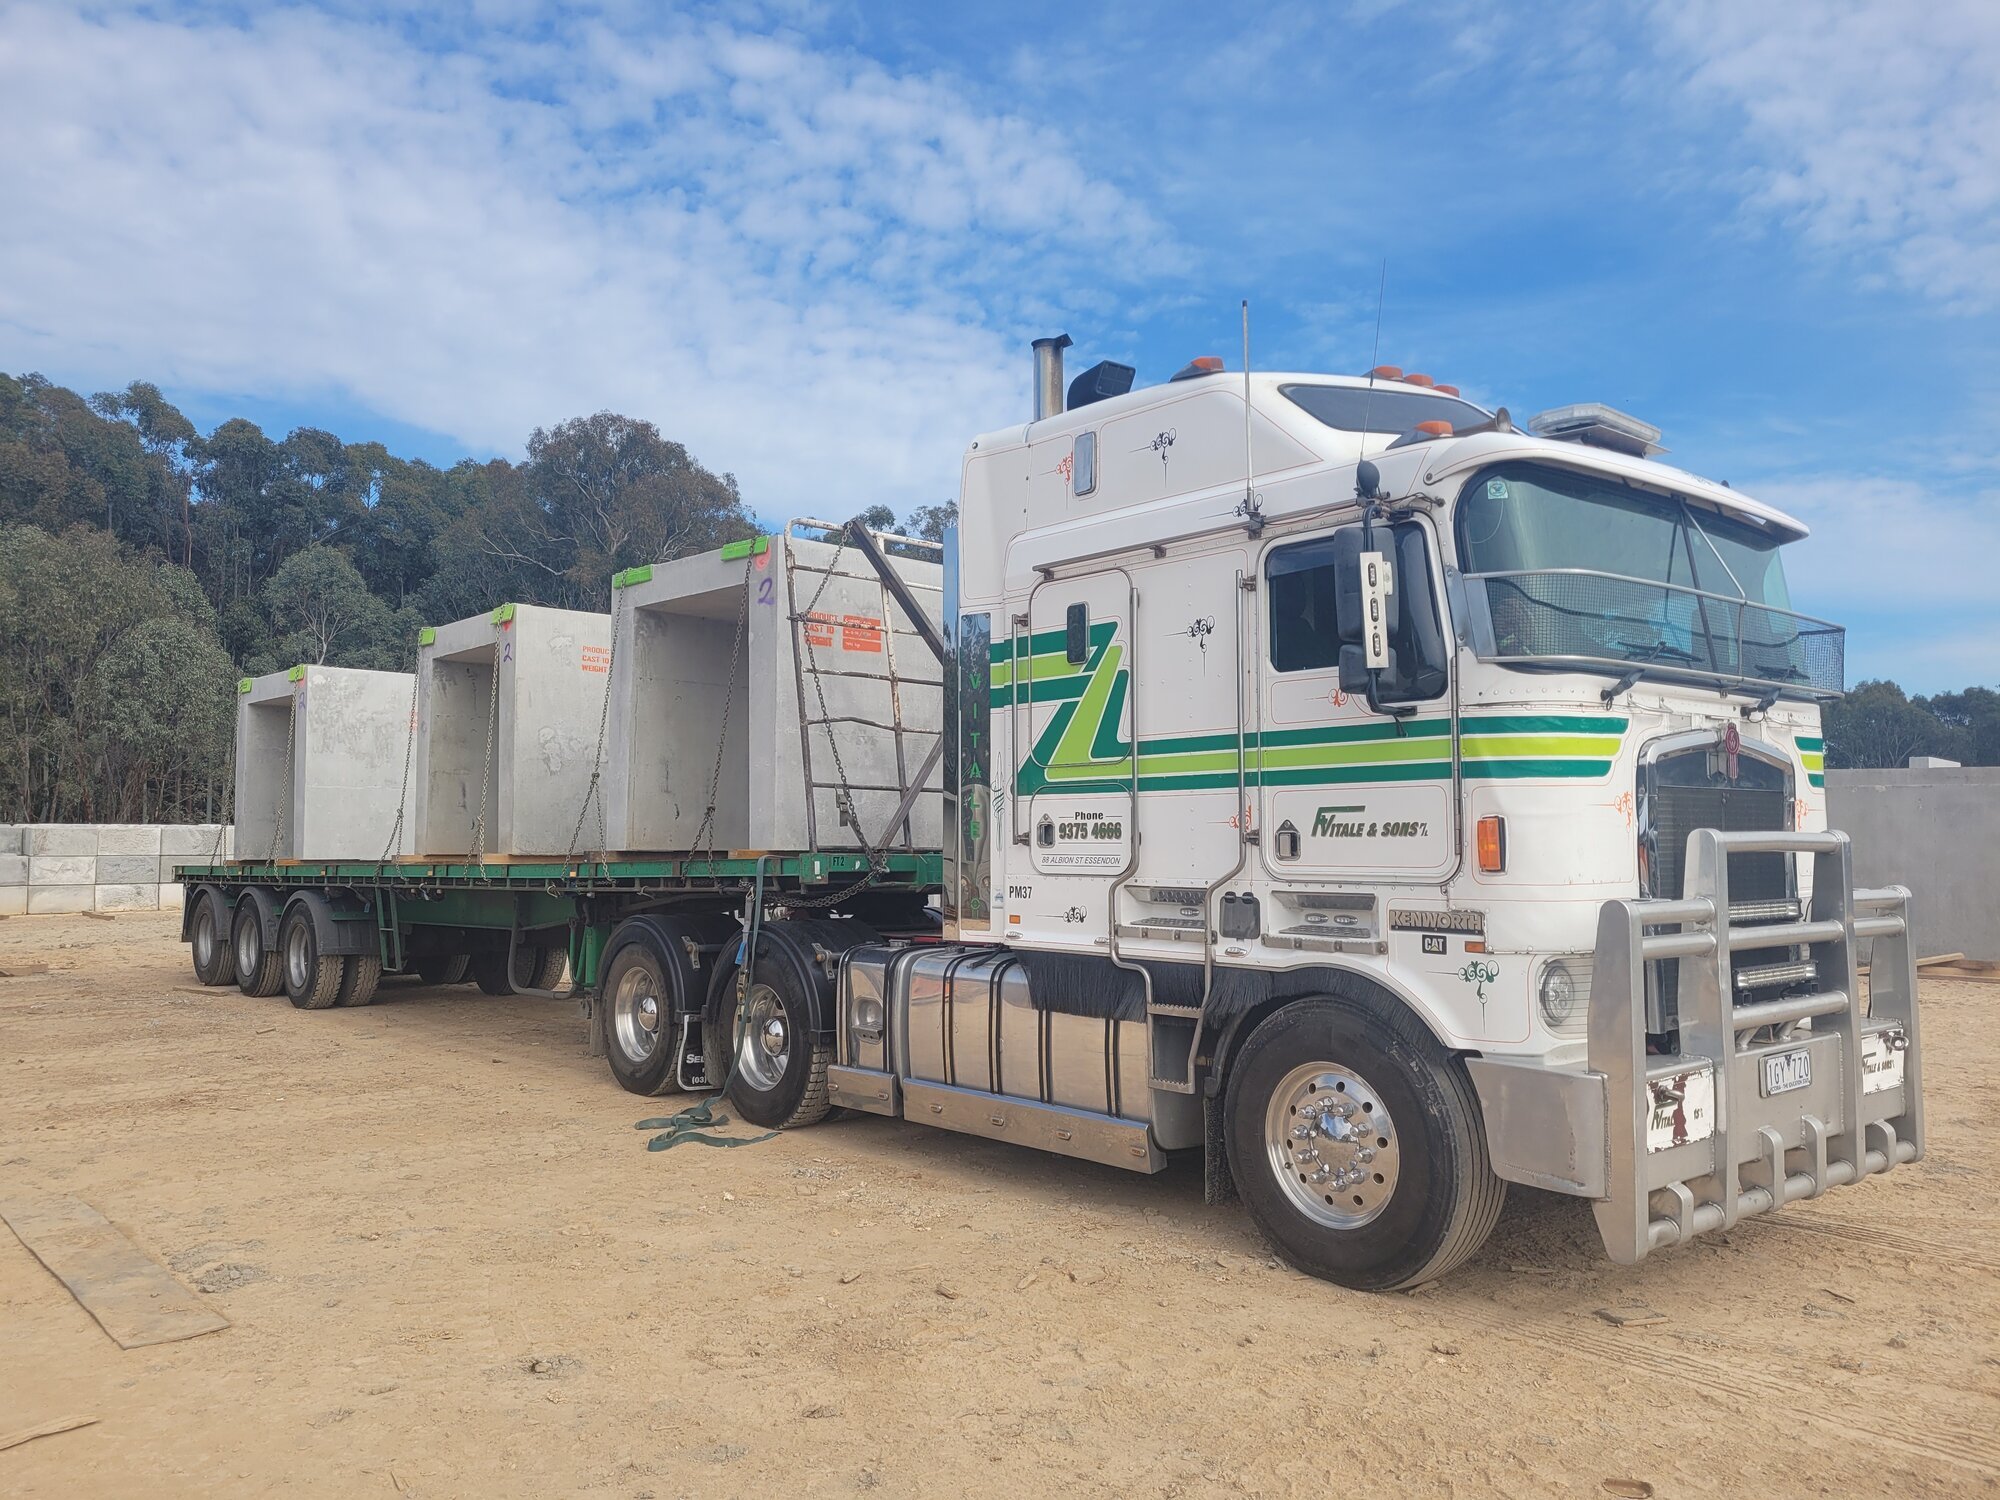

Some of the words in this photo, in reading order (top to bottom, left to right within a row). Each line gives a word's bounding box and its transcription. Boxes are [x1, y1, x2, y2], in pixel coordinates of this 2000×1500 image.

[757, 577, 775, 605] 2
[503, 642, 512, 662] 2
[582, 646, 610, 654] PRODUC
[582, 664, 608, 673] WEIGHT
[298, 692, 306, 709] 2
[968, 673, 982, 841] VITALE
[1074, 812, 1104, 820] Phone
[1058, 822, 1088, 840] 9375
[1091, 822, 1122, 840] 4666
[1366, 822, 1378, 837] &
[1380, 821, 1419, 837] SONS
[832, 856, 840, 866] FT
[840, 856, 844, 866] 2
[1084, 856, 1120, 864] ESSENDON
[1009, 886, 1032, 898] PM37
[1392, 910, 1482, 930] KENWORTH
[1425, 938, 1444, 952] CAT
[686, 1054, 704, 1064] SEL
[692, 1076, 707, 1084] (03)
[1769, 1062, 1786, 1086] 1GY
